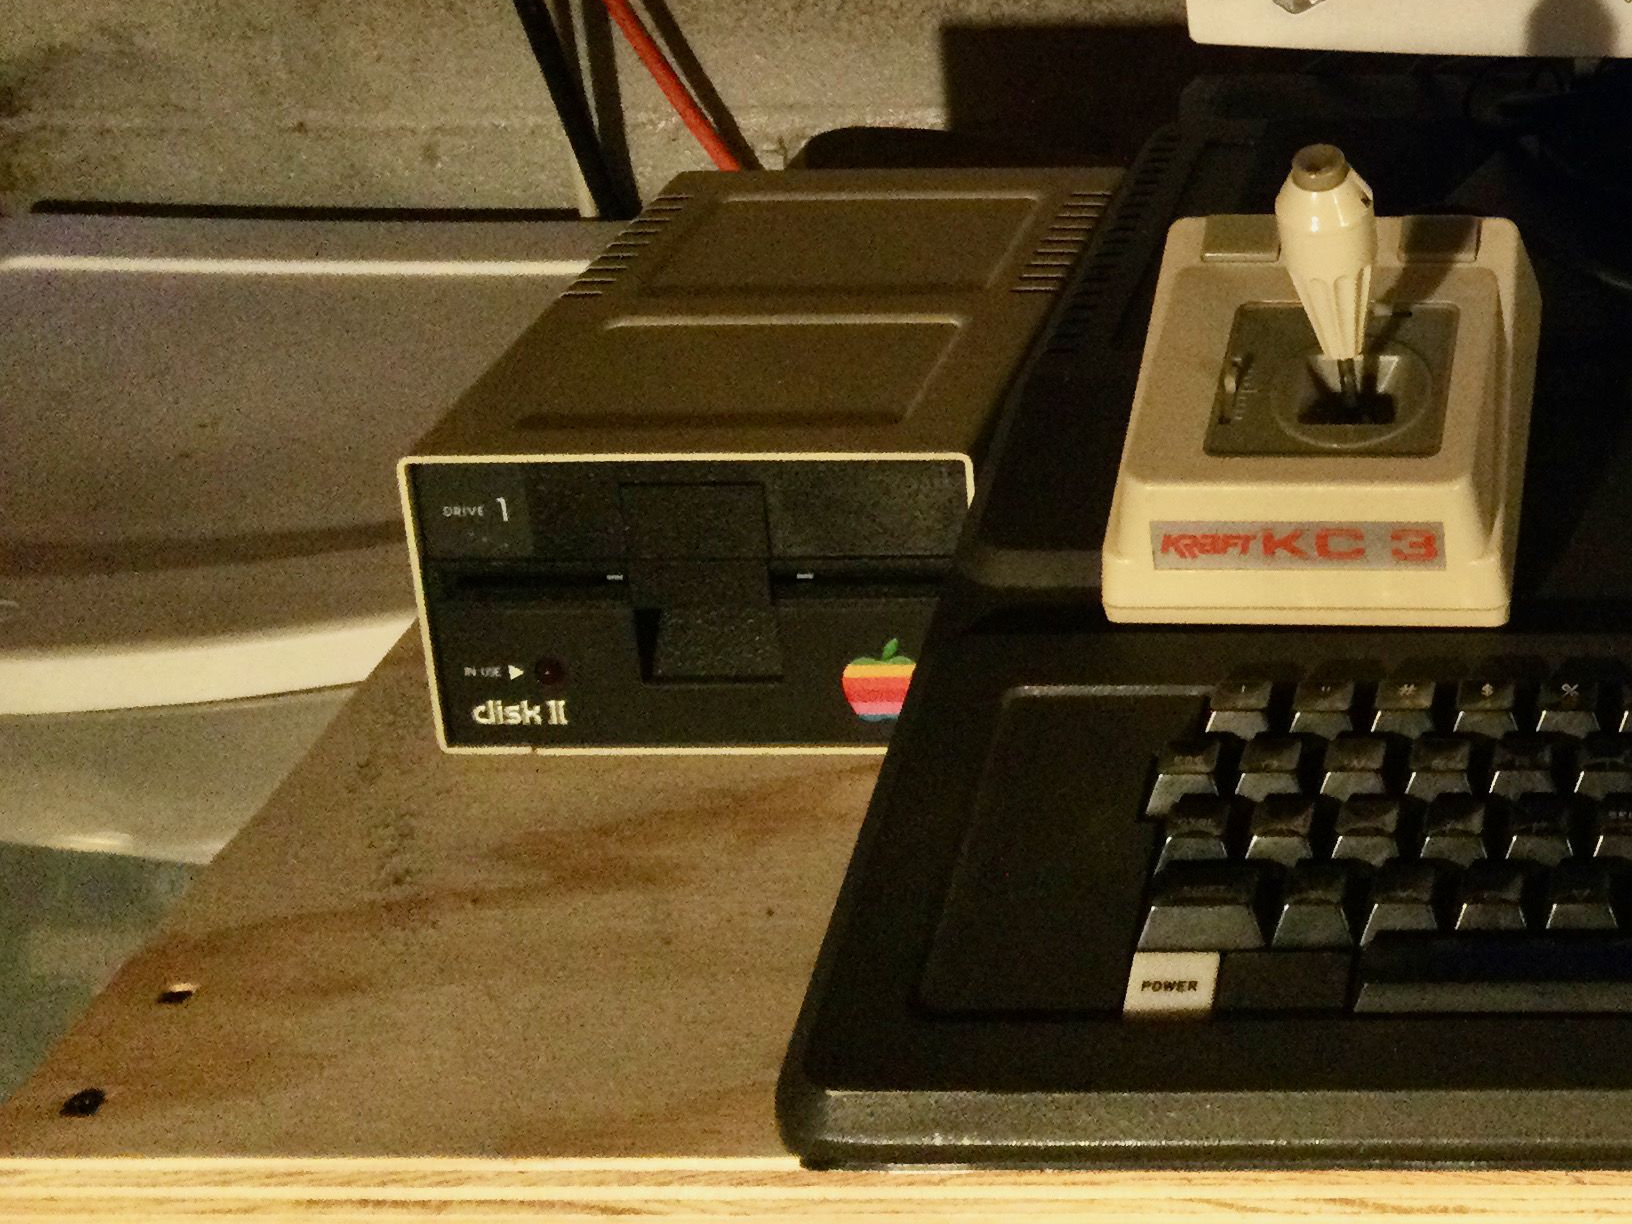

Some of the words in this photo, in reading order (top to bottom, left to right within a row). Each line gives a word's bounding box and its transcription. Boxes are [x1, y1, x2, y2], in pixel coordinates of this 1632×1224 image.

[442, 506, 485, 518] DRIVE
[496, 496, 509, 522] 1
[1390, 528, 1438, 562] 3
[470, 699, 543, 726] disk
[1141, 980, 1199, 992] POWER
